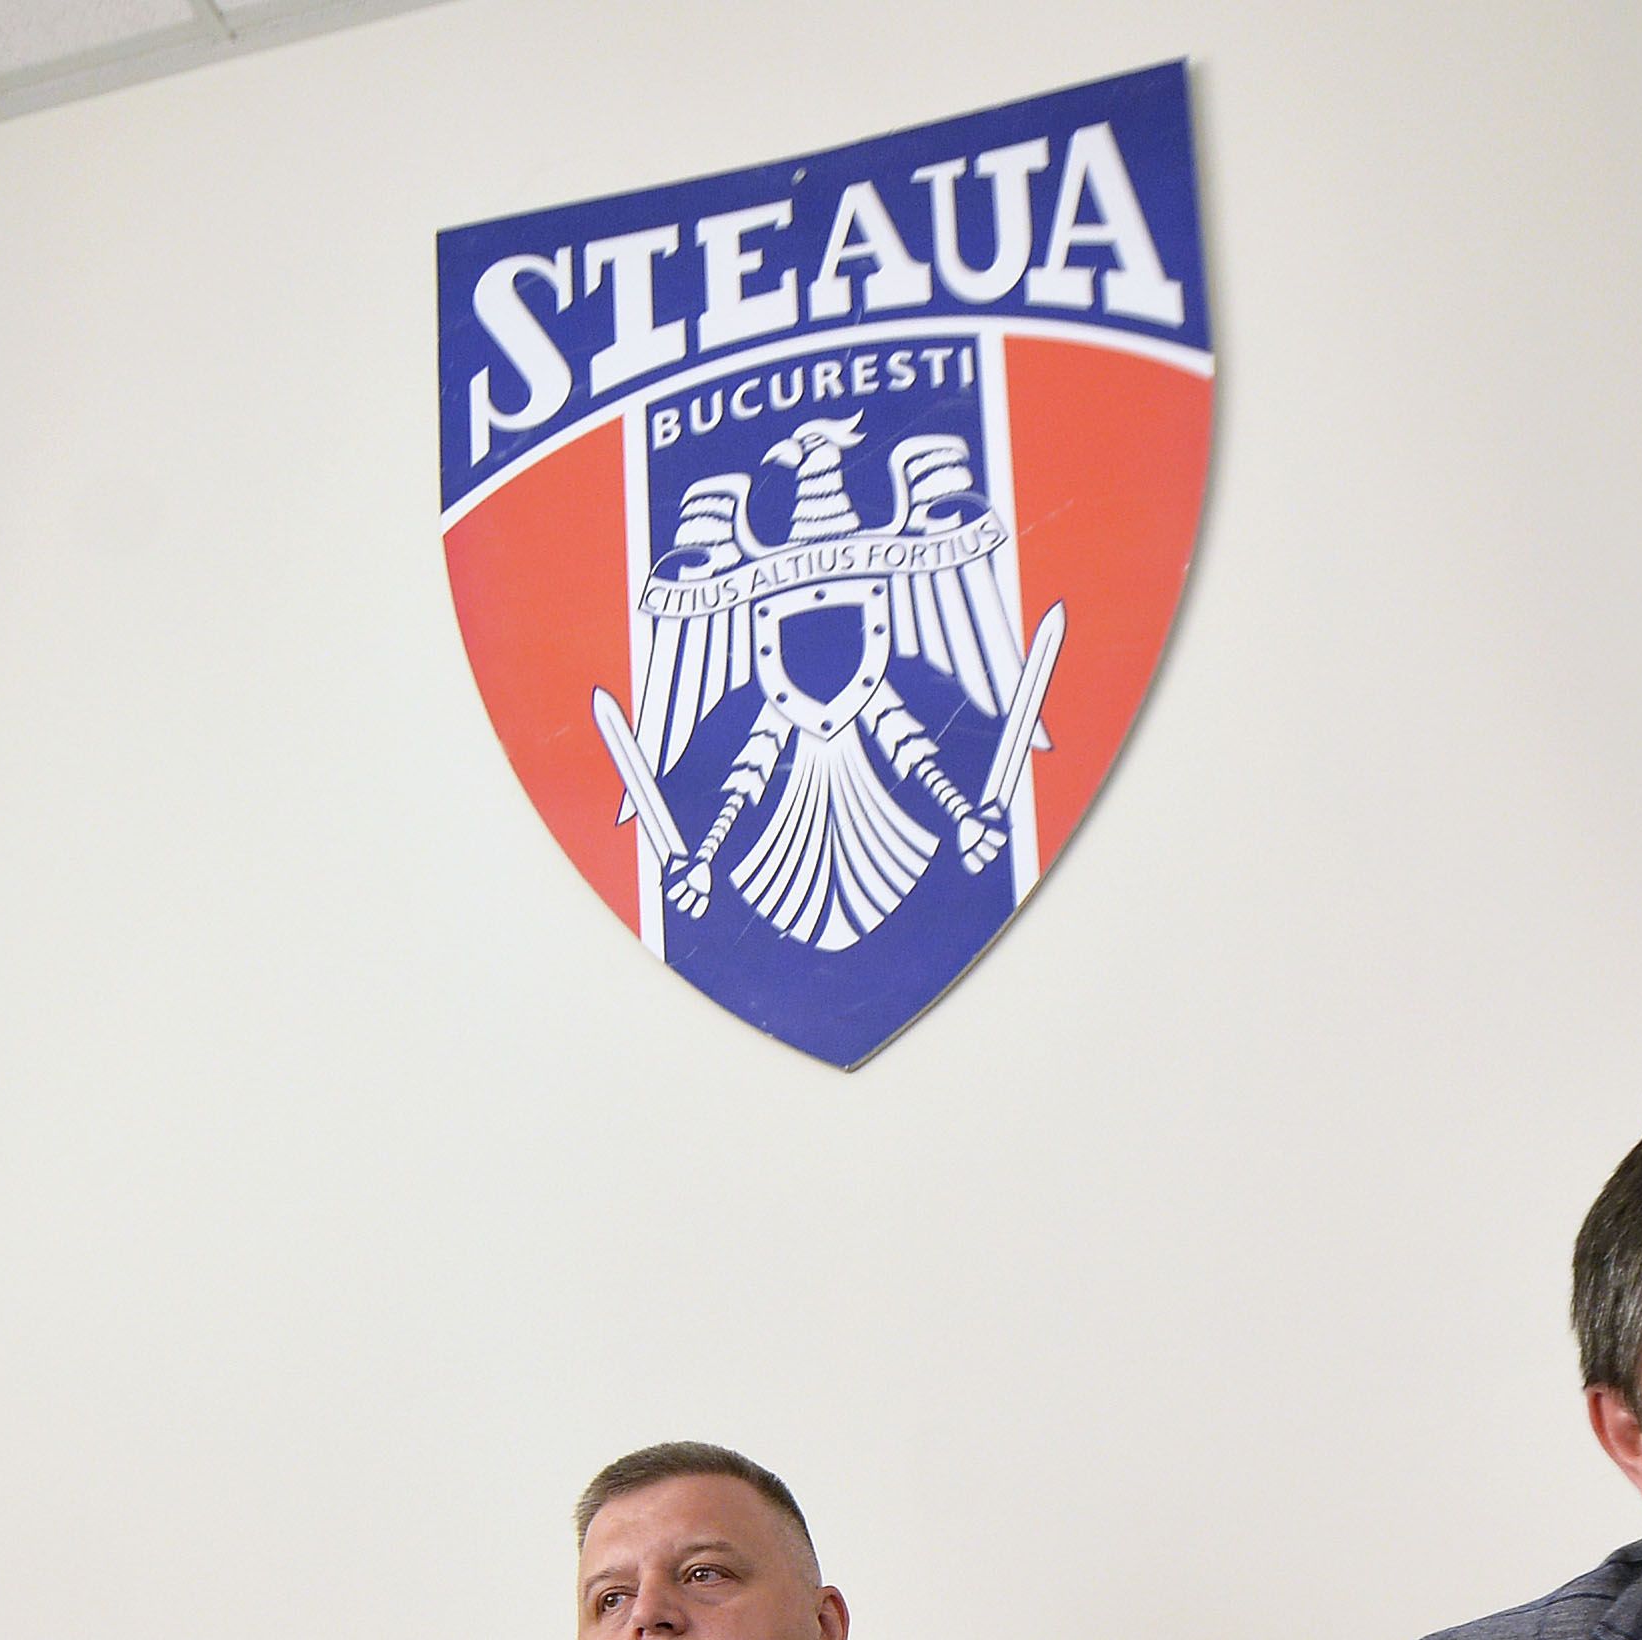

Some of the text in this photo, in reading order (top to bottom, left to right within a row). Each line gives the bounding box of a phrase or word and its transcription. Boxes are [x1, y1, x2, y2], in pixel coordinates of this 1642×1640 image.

[469, 120, 1185, 468] STEAUA
[651, 345, 975, 451] BUCURESTI
[644, 518, 1002, 612] CITIUS ALTIUS FORTIUS
